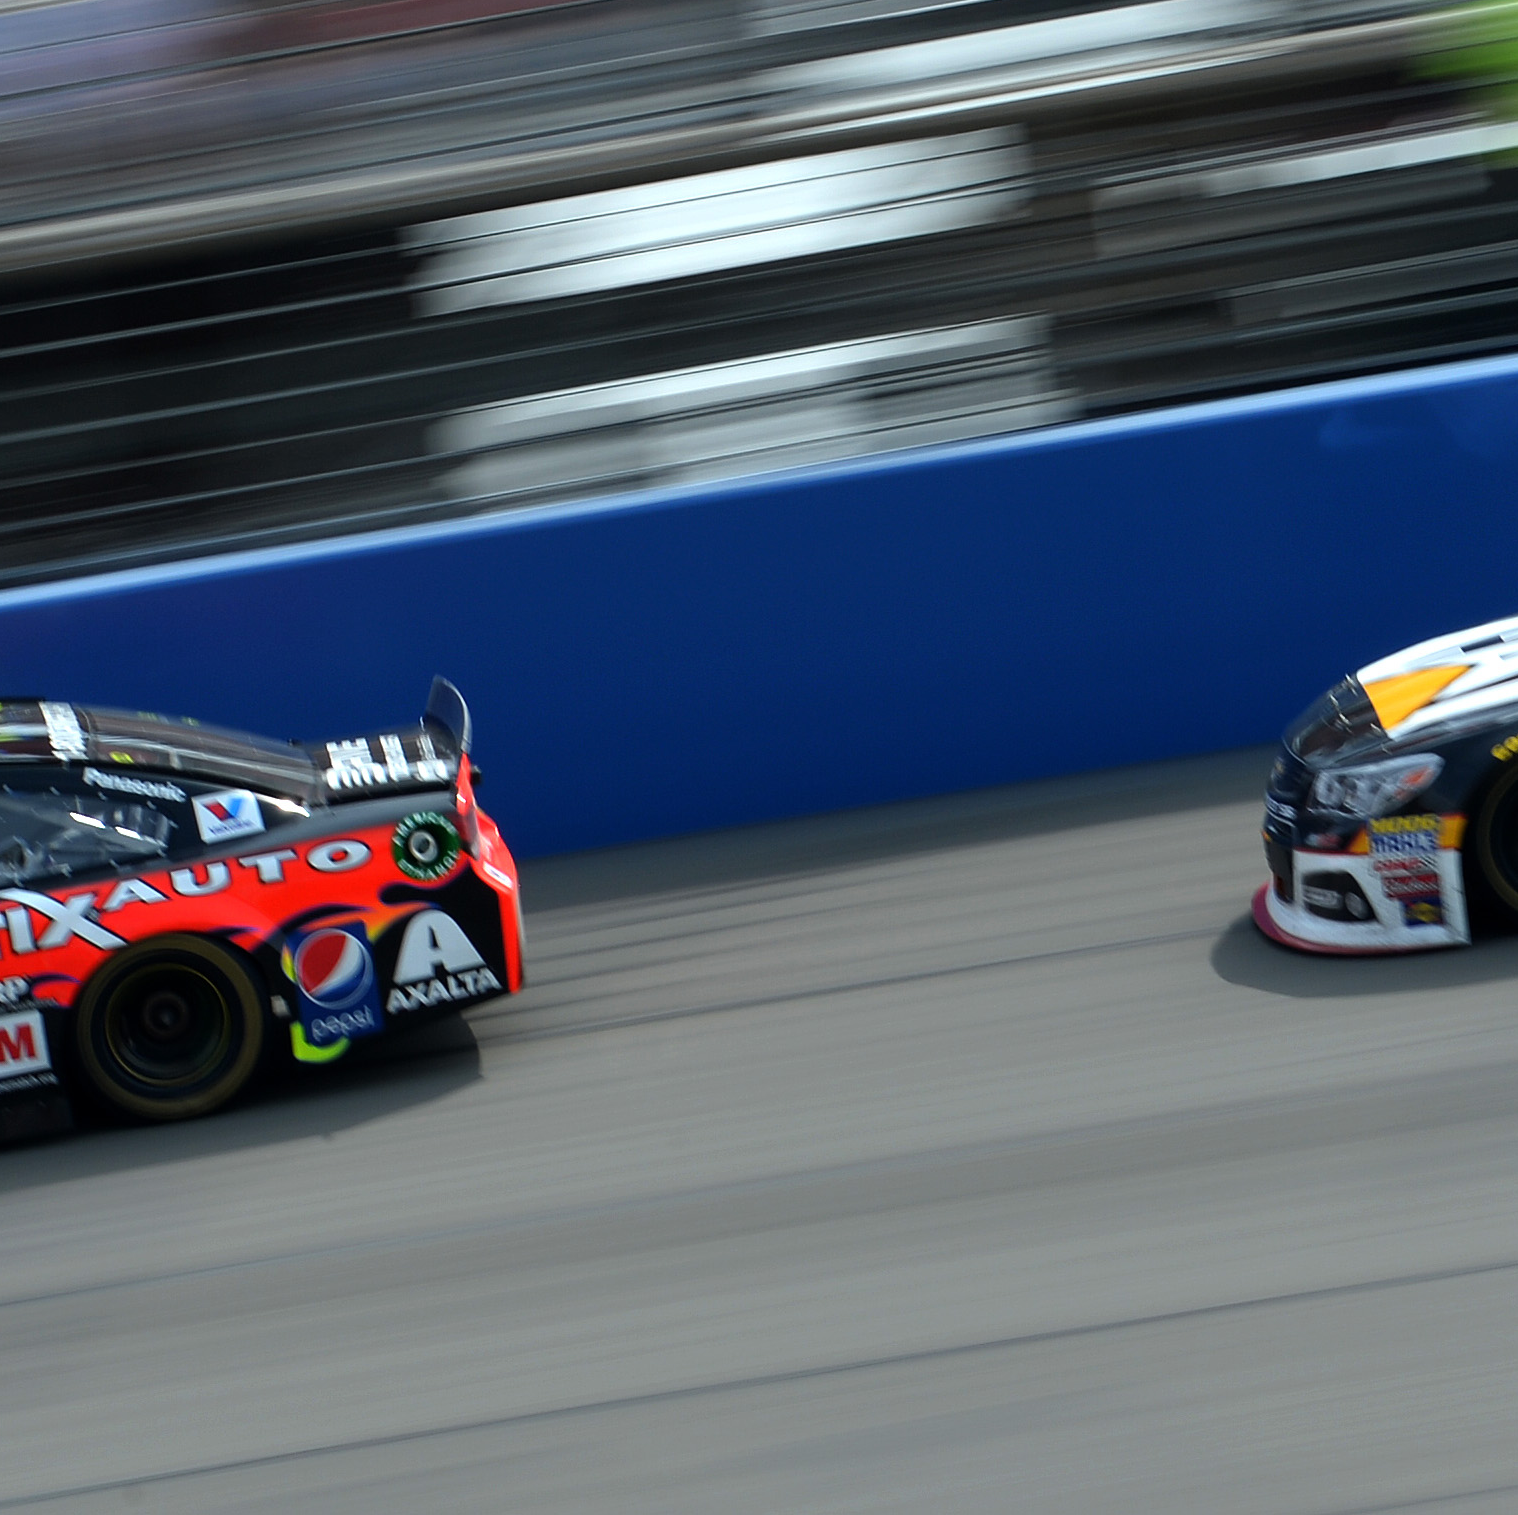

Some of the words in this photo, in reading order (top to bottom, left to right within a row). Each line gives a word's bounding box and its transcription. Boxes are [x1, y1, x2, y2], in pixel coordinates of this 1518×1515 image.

[102, 838, 372, 912] AUTO
[386, 966, 503, 1015] AXALTA
[311, 1004, 375, 1042] pepsi
